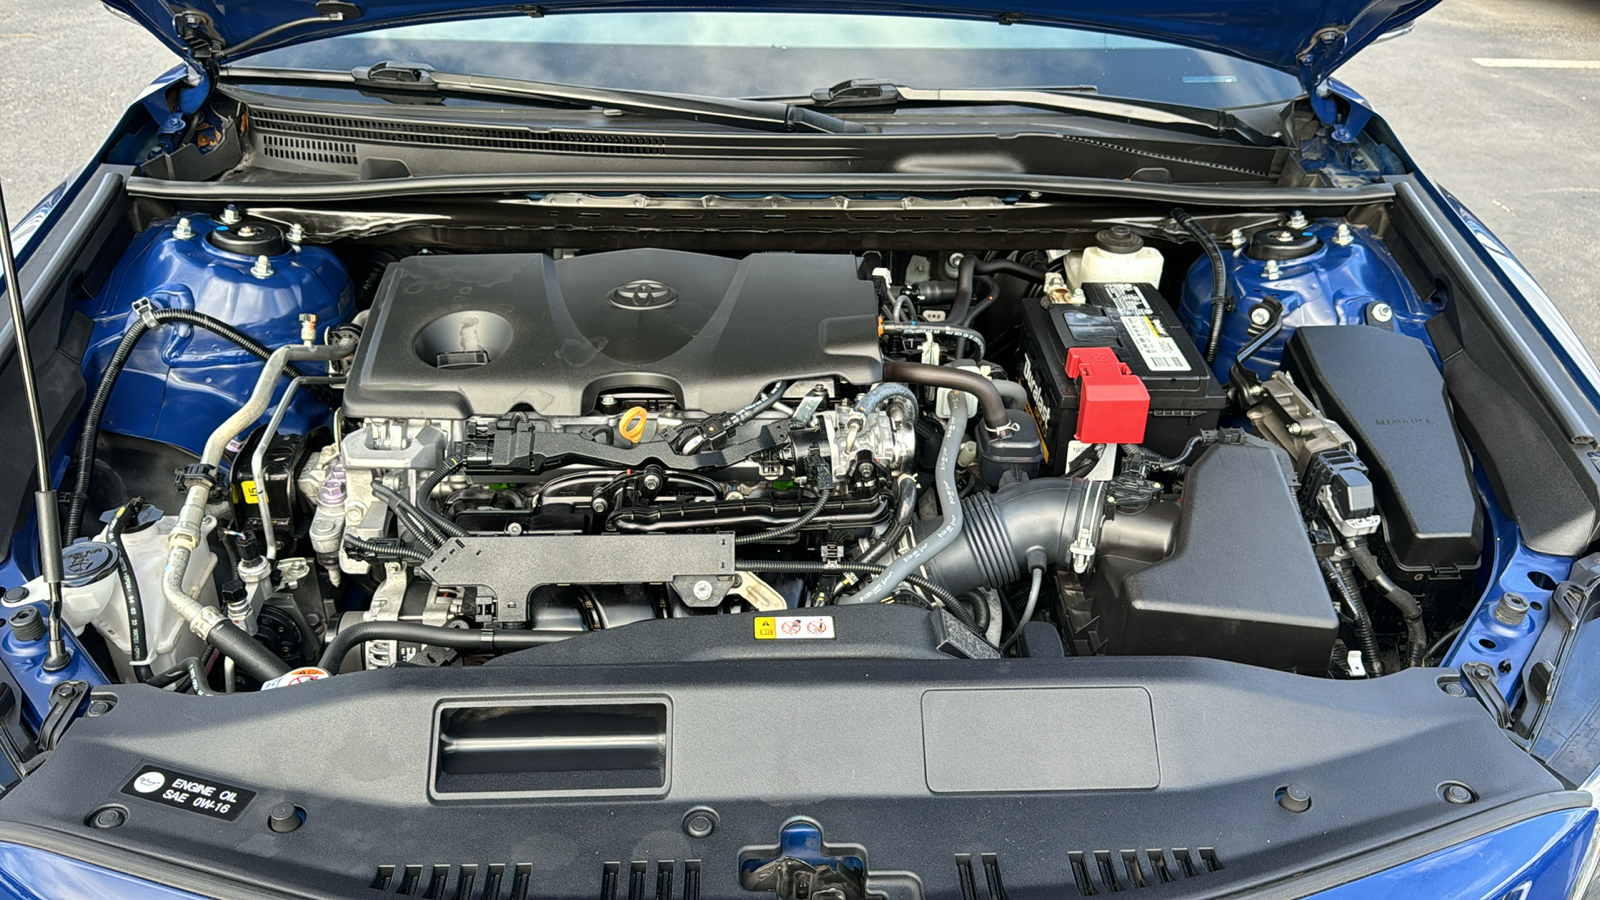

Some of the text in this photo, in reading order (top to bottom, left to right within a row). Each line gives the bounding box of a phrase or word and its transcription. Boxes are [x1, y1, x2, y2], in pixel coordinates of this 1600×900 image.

[1023, 352, 1051, 430] Duralast
[162, 789, 231, 814] SAE 0W-16
[171, 778, 238, 803] ENGINE OIL
